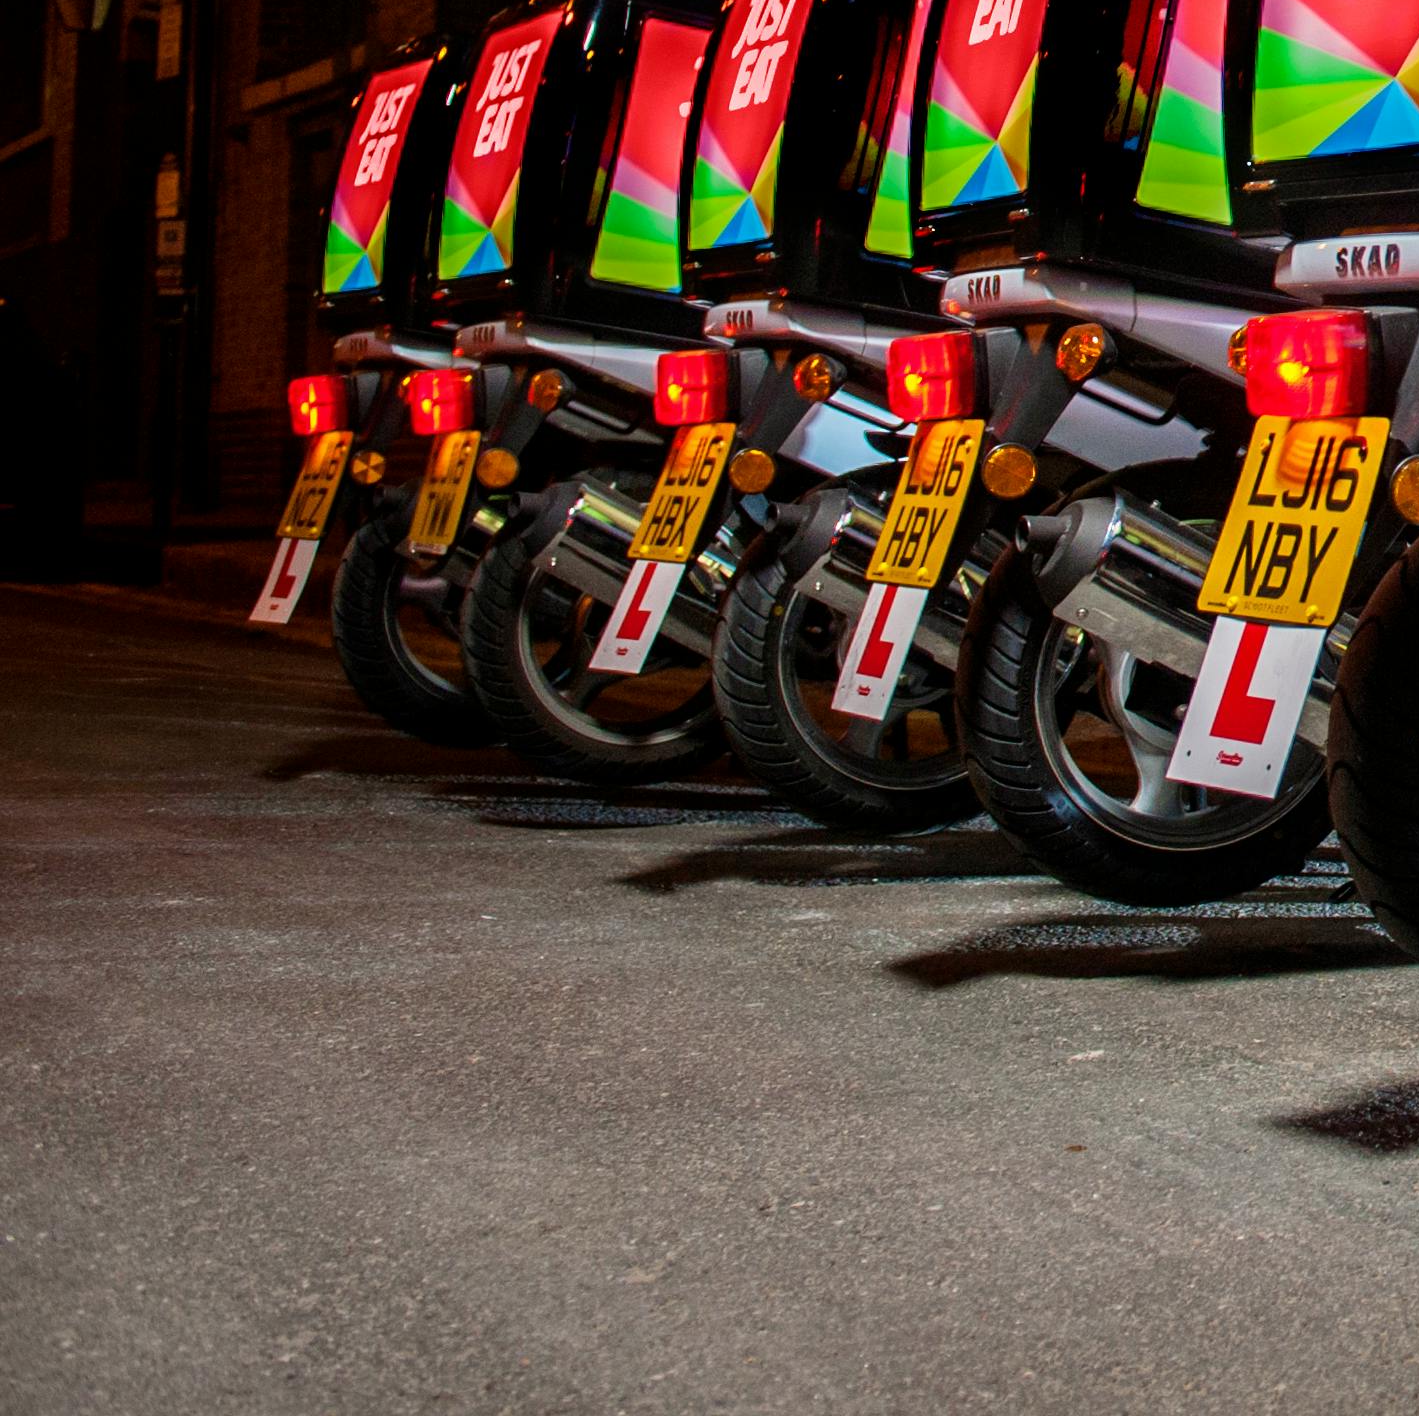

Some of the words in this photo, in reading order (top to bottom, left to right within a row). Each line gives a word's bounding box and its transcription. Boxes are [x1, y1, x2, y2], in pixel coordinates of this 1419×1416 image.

[476, 40, 541, 111] JUST
[728, 40, 789, 112] EAT
[359, 84, 415, 145] JUST
[473, 97, 524, 158] EAT
[354, 134, 398, 187] EAT
[1335, 243, 1401, 277] SKAD
[1248, 432, 1368, 512] LJ16
[642, 494, 700, 548] HBX
[883, 506, 949, 569] HBY
[1224, 520, 1340, 604] NBY
[616, 561, 657, 641] L
[856, 585, 899, 679] L
[1210, 621, 1276, 745] L
